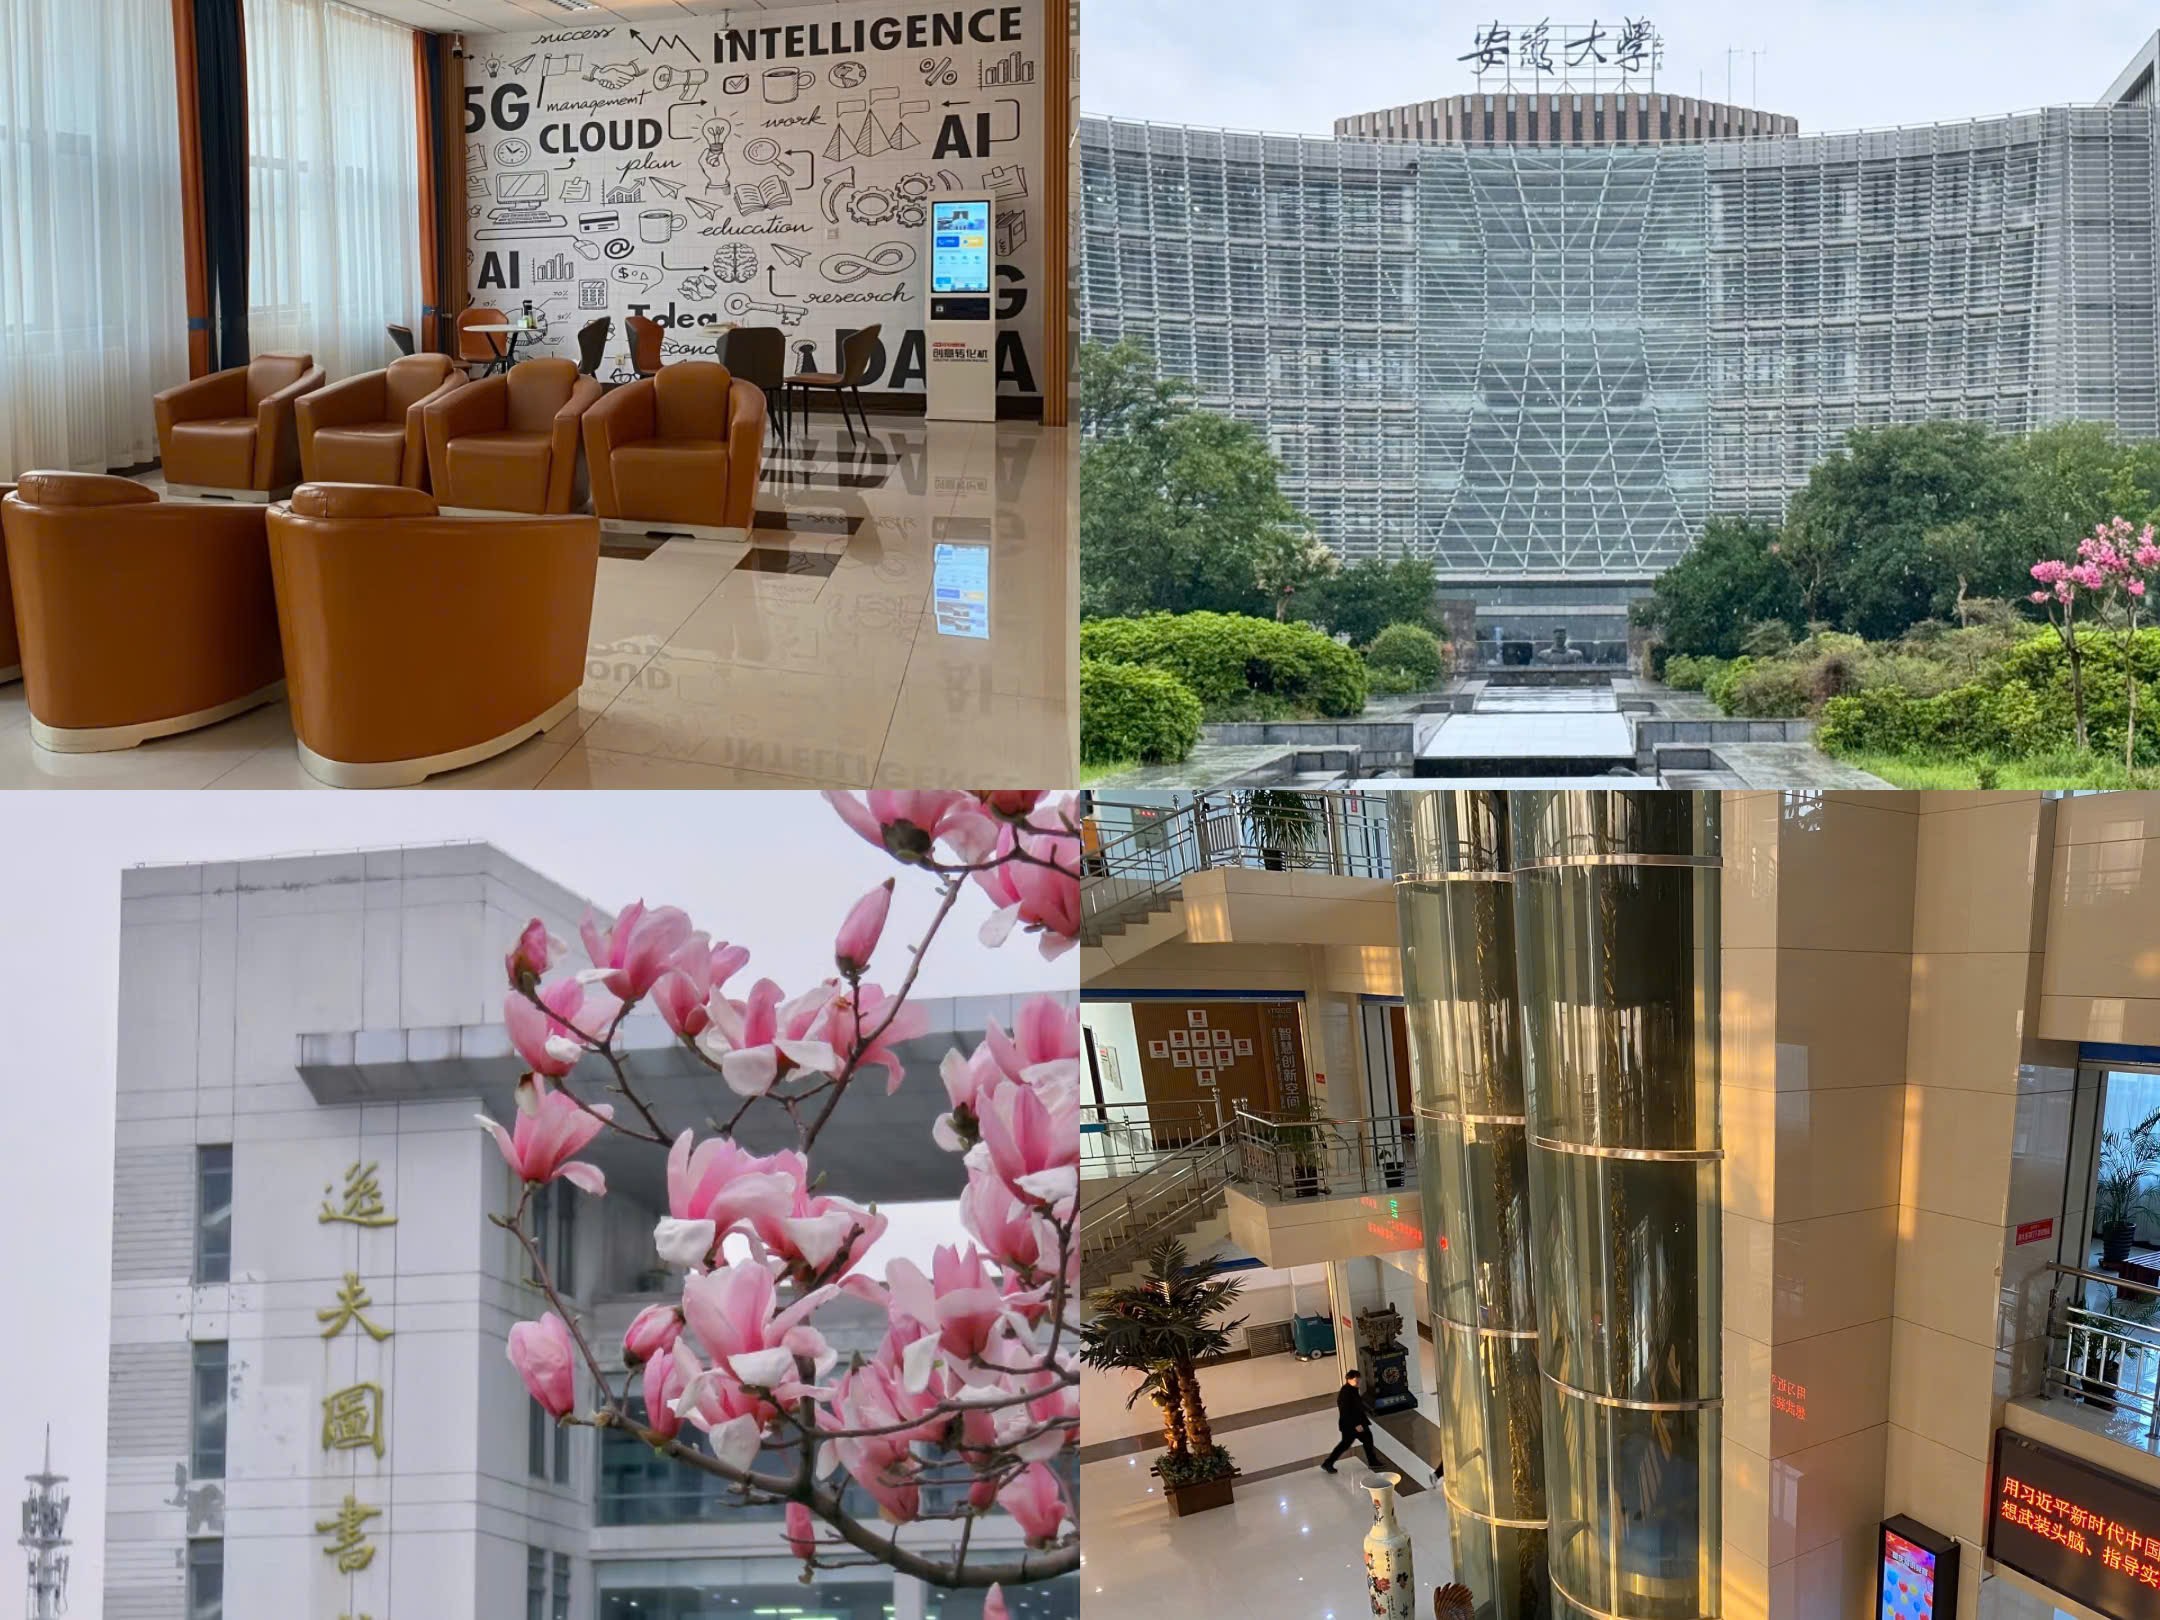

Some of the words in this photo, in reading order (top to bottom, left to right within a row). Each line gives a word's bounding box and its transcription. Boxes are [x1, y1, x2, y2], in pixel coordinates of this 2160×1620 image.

[531, 27, 616, 45] success
[714, 7, 1022, 64] INTELLIGENCE
[464, 83, 529, 134] 5G
[546, 89, 653, 117] management
[761, 105, 827, 128] work
[539, 118, 662, 154] CLOUD
[932, 112, 990, 159] AI
[616, 152, 682, 184] plan
[697, 214, 813, 237] education
[477, 251, 520, 289] AI
[803, 282, 915, 304] research
[835, 329, 1038, 392] DAA
[316, 1161, 399, 1620] 逸夫圖書
[2003, 1476, 2160, 1562] 用习近平新时代中国
